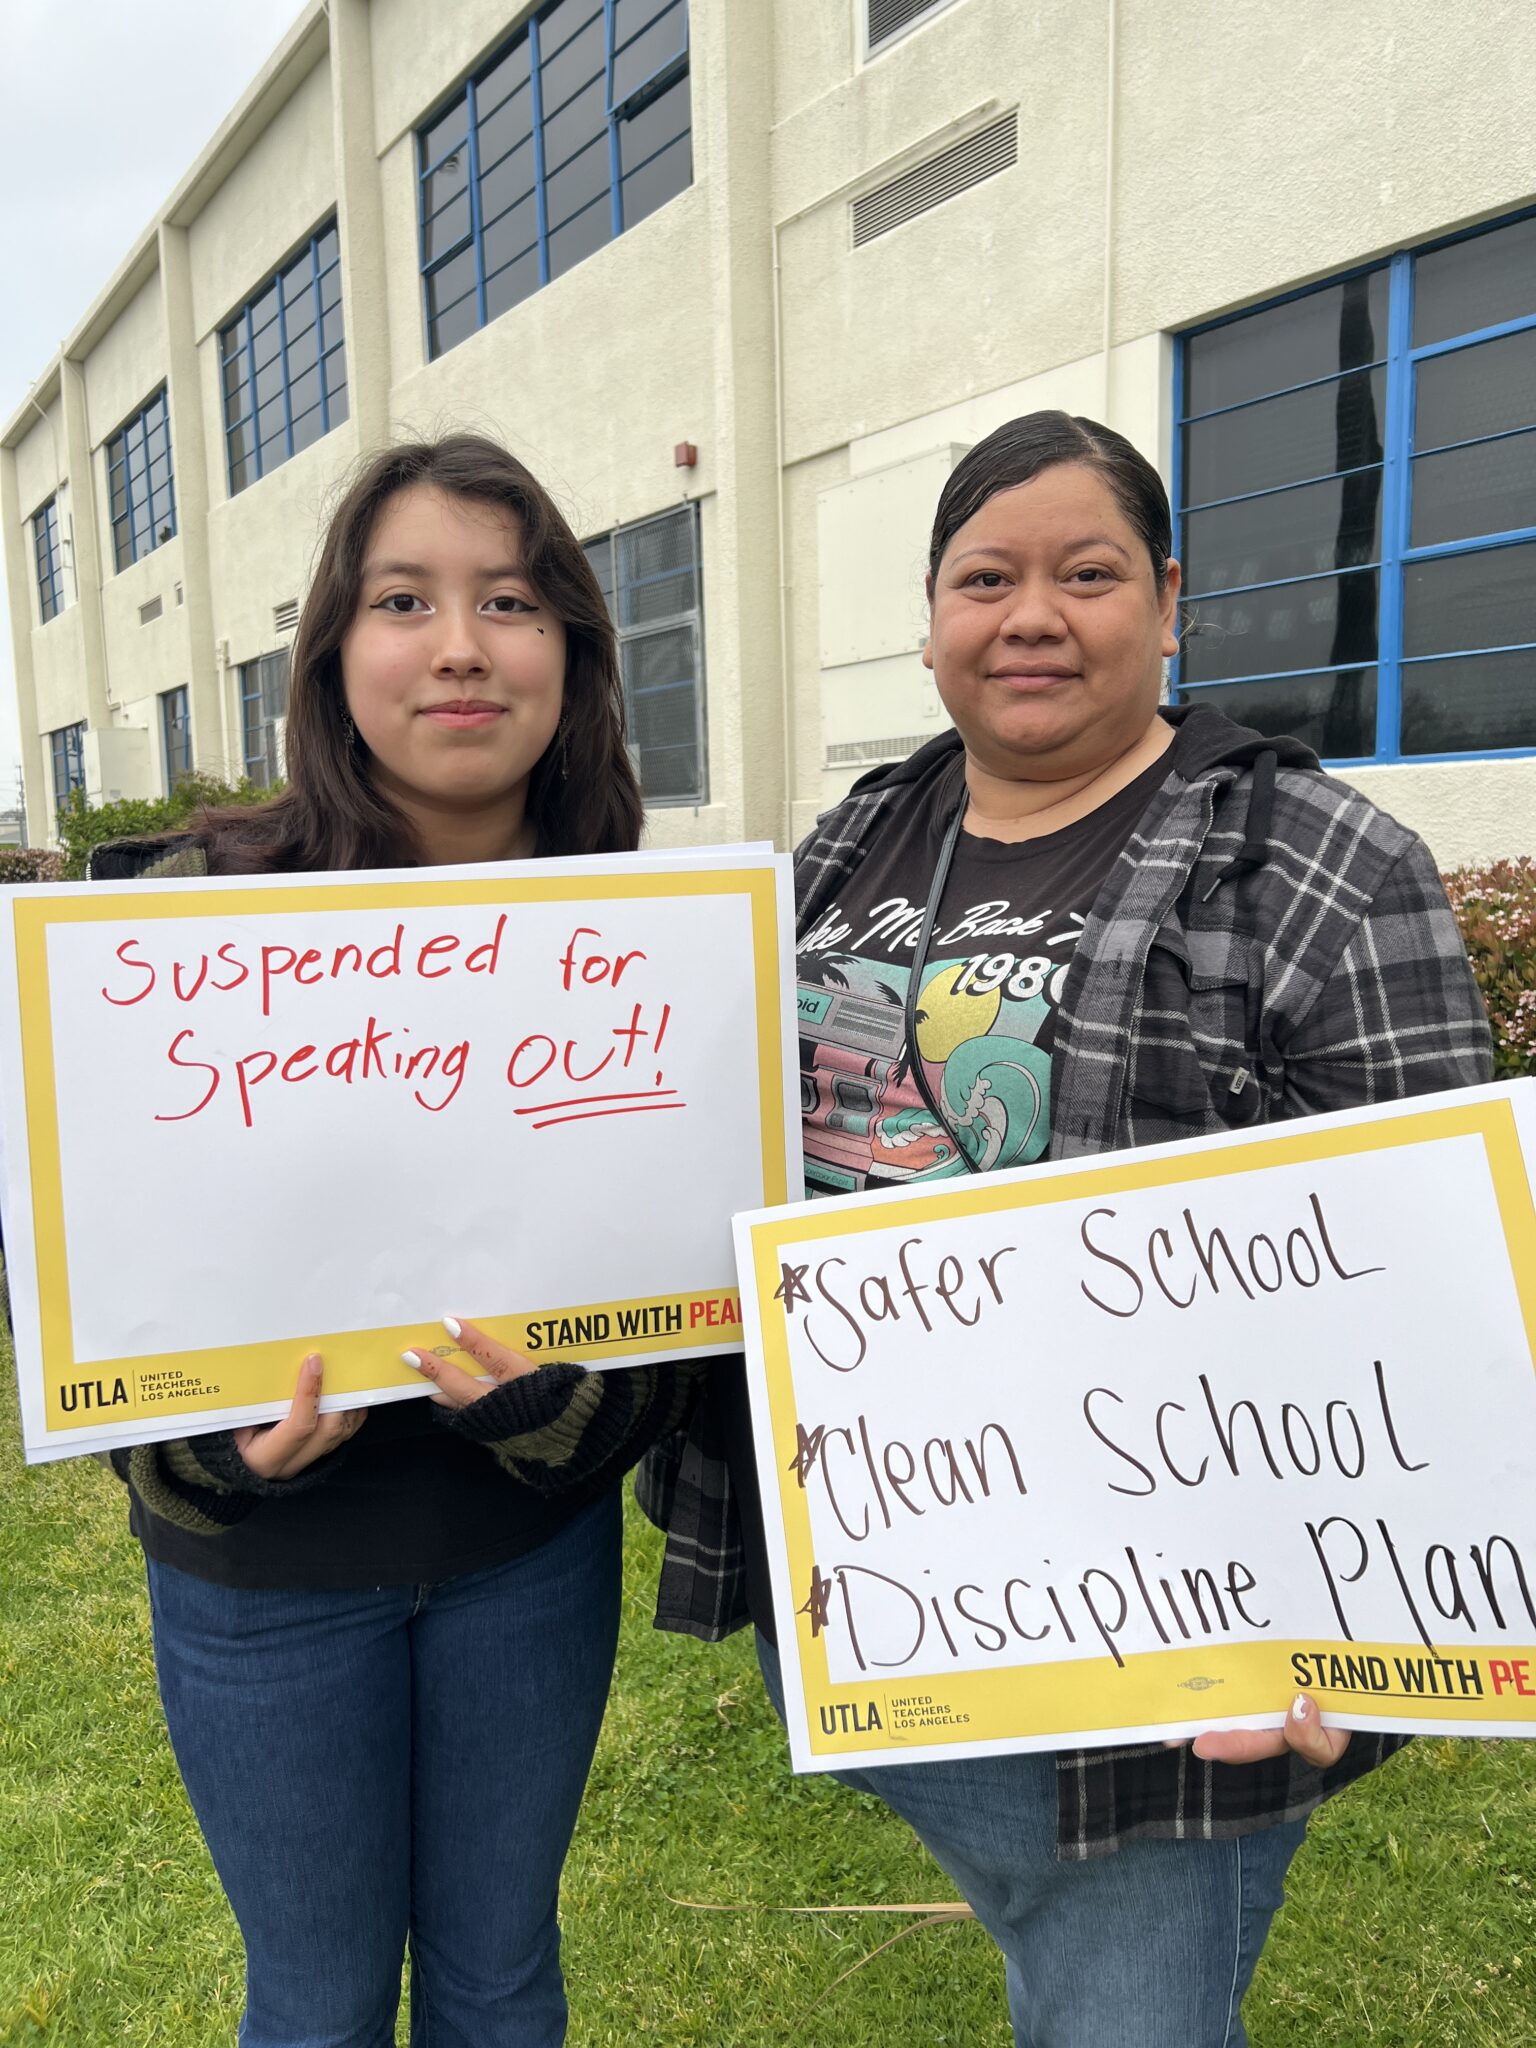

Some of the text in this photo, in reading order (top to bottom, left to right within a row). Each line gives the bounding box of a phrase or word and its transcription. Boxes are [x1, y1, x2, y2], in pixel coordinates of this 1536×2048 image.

[937, 900, 1053, 945] Back
[102, 914, 647, 1017] Suspended for
[155, 1016, 470, 1128] Speaking
[803, 1192, 1386, 1372] Safer School
[526, 1313, 610, 1350] STAND
[617, 1304, 682, 1337] WITH
[60, 1377, 129, 1412] UTLA
[140, 1371, 183, 1382] UNITED
[140, 1378, 202, 1392] TEACHERS
[141, 1385, 221, 1402] LOS ANGELES
[820, 1360, 1430, 1541] Clean School
[832, 1516, 1536, 1669] Discipline Plan
[1291, 1652, 1536, 1696] STAND WITH PE
[819, 1701, 883, 1735] UTLA
[891, 1696, 932, 1708] UNITED
[892, 1704, 951, 1718] TEACHERS
[894, 1714, 970, 1729] LOS ANGELES
